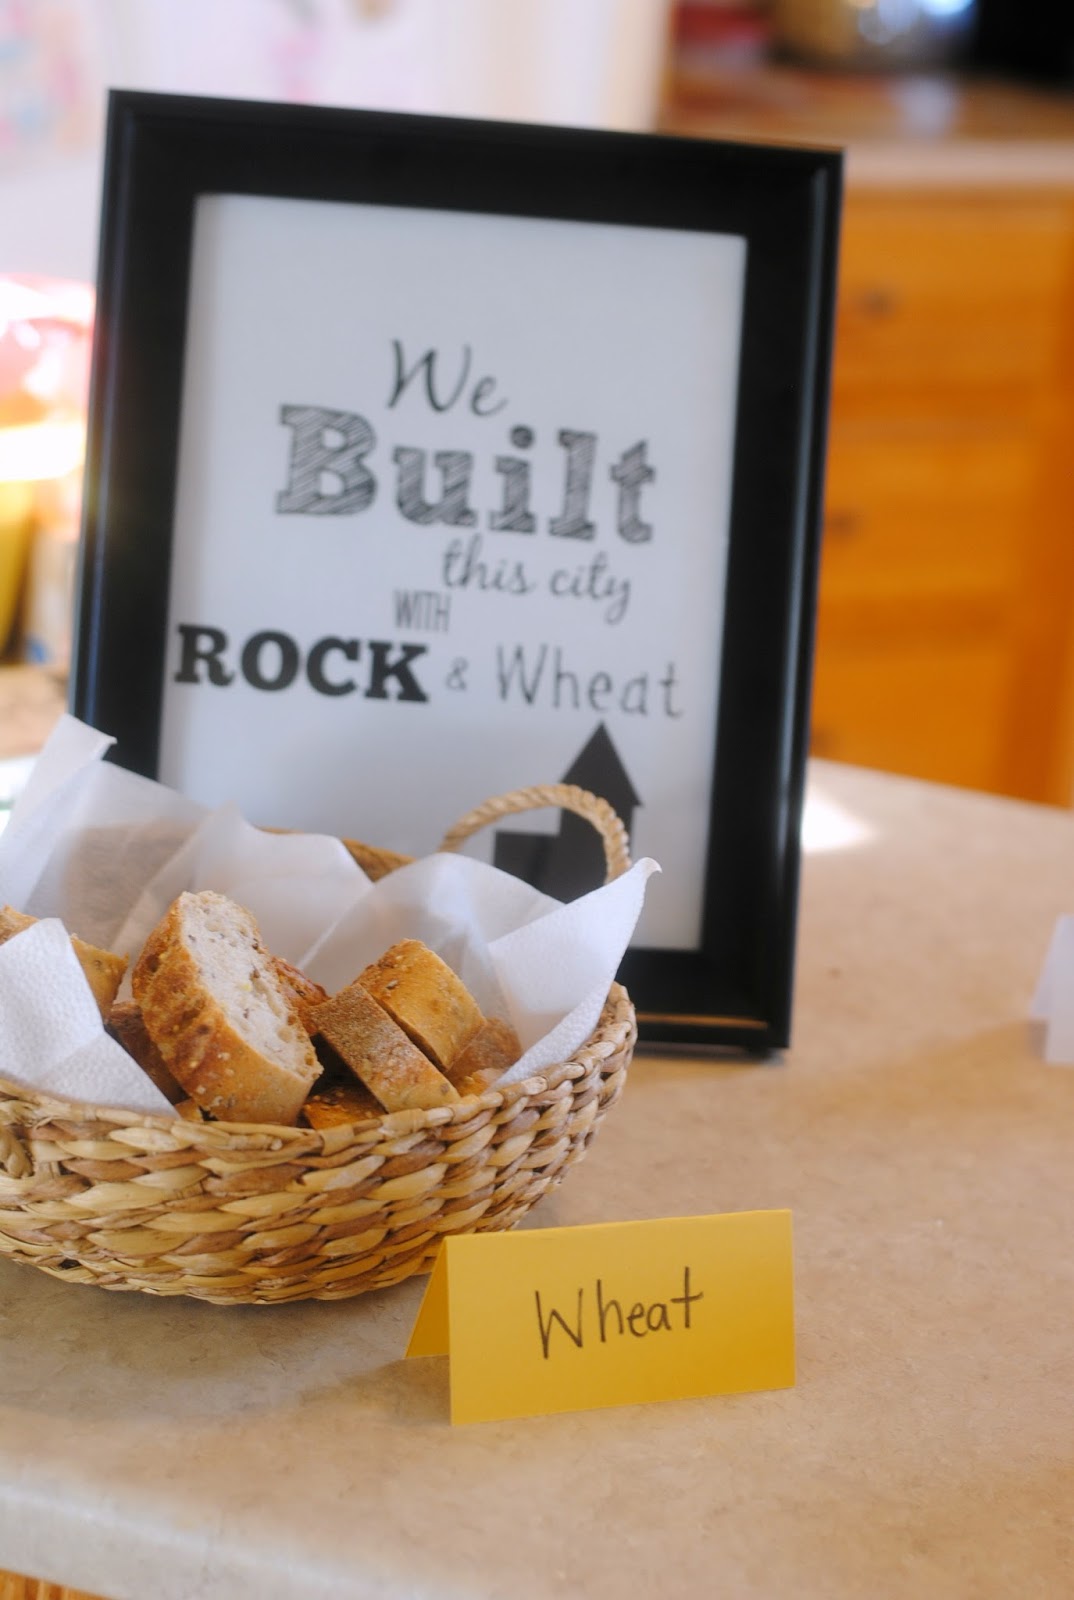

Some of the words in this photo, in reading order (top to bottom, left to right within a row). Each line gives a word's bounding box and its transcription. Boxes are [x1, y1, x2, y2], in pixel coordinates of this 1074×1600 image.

[386, 339, 507, 417] We
[274, 402, 657, 544] Built
[393, 589, 450, 633] WITH
[442, 533, 537, 596] this
[549, 551, 632, 625] city
[173, 623, 430, 704] ROCK
[445, 657, 469, 692] &
[496, 642, 684, 719] Wheat
[534, 1266, 704, 1360] Wheat
